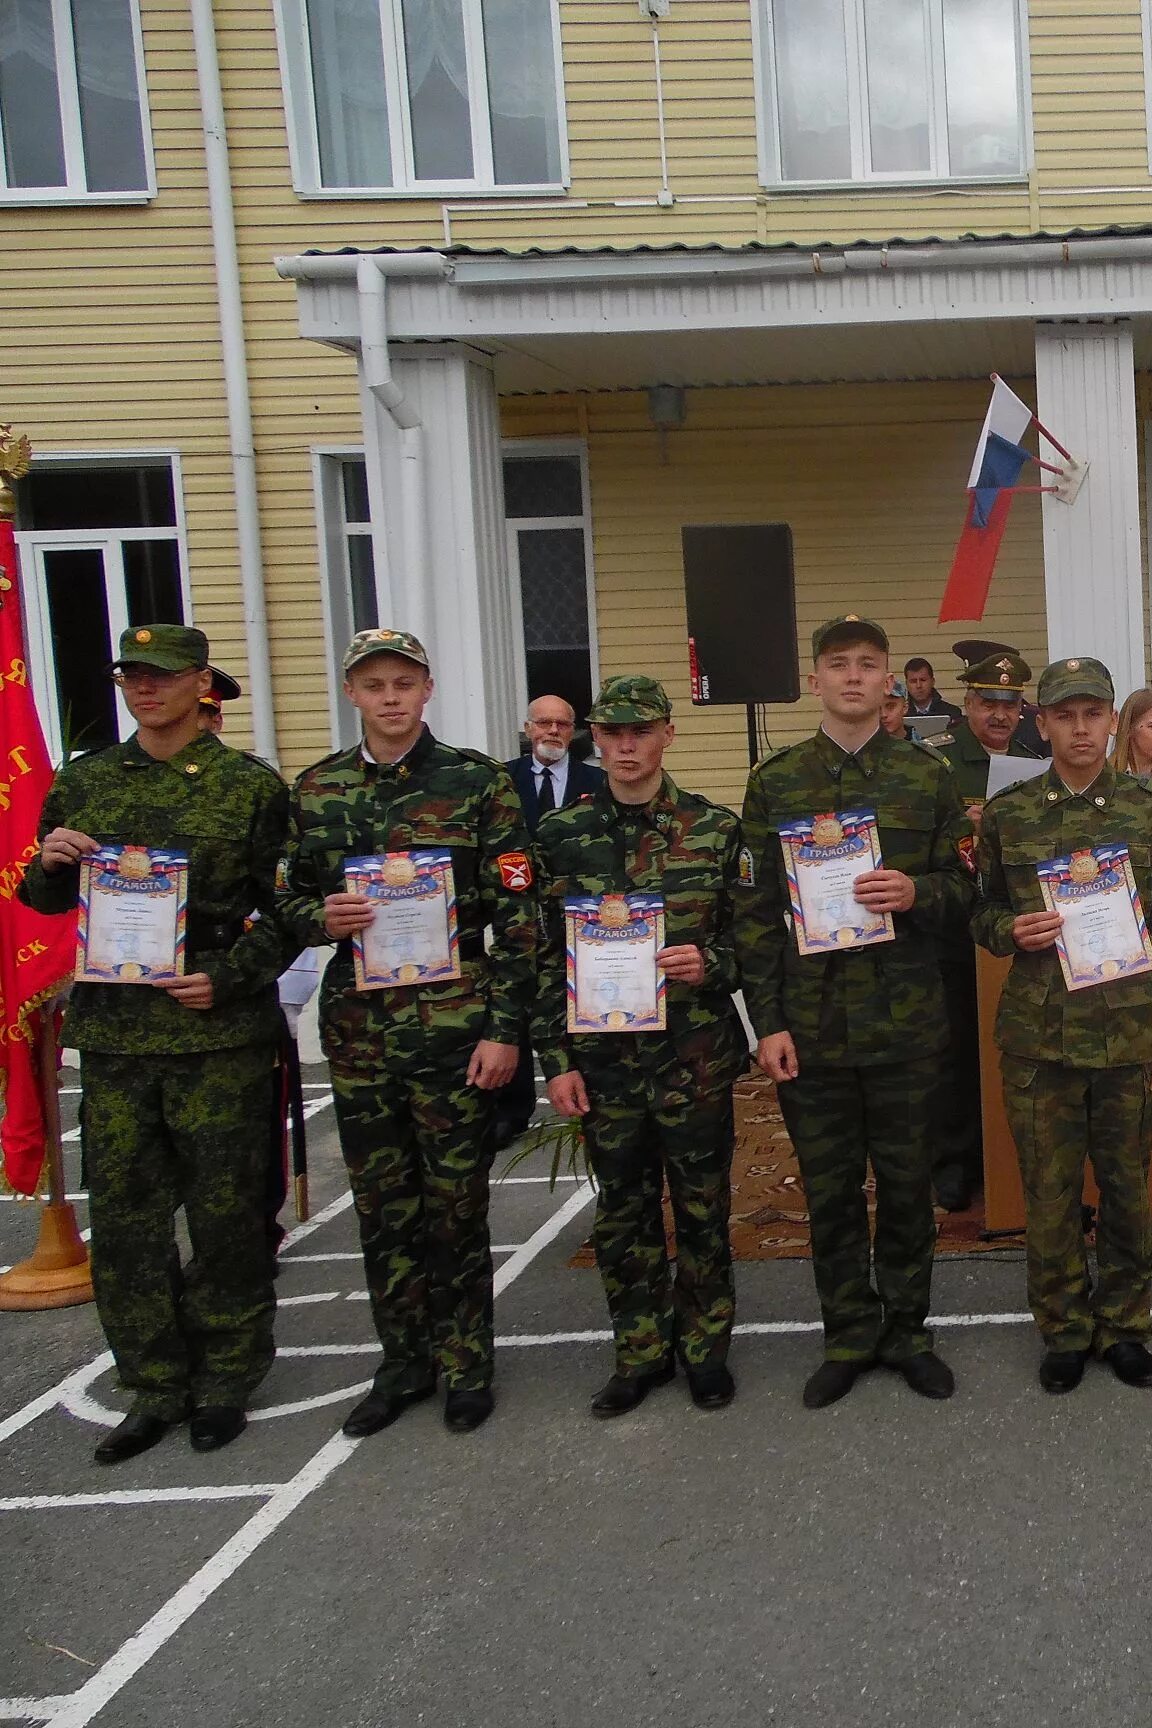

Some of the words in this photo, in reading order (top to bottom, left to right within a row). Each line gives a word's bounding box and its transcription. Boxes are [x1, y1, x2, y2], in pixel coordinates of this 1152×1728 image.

[702, 675, 710, 699] OPERA
[810, 842, 857, 858] ГРАМОТА
[110, 878, 162, 891] ГРАМОТА
[377, 884, 429, 898] ГРАМОТА
[1068, 878, 1113, 895] ГРАМОТА
[592, 927, 640, 939] ГРАМОТА
